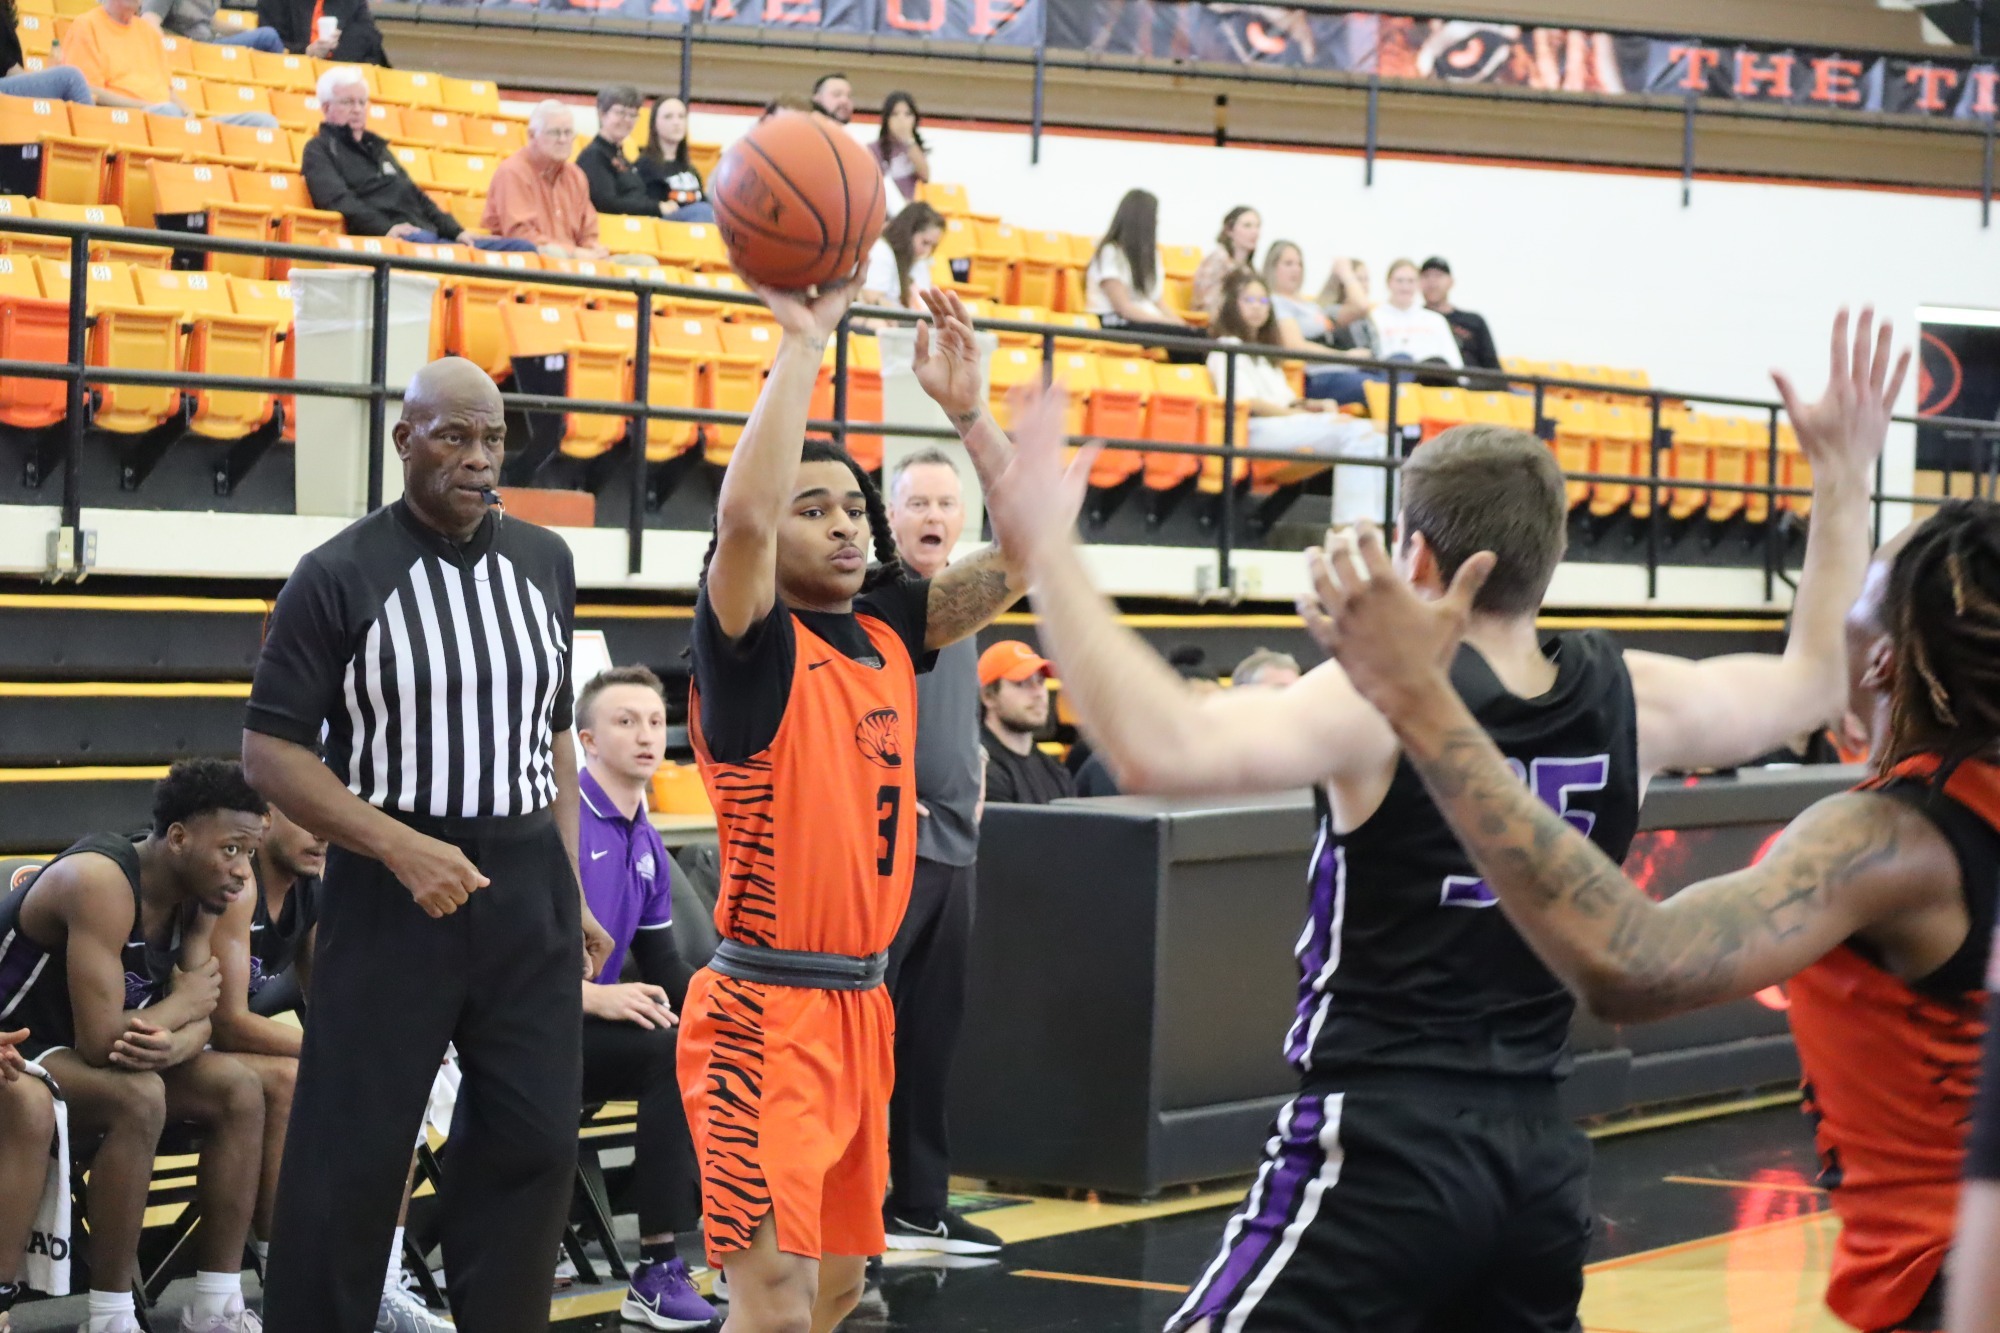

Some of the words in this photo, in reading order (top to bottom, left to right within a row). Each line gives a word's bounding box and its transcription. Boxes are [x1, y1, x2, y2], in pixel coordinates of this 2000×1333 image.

[1668, 46, 1864, 105] THE
[1905, 67, 2000, 114] TI
[876, 784, 902, 877] 3
